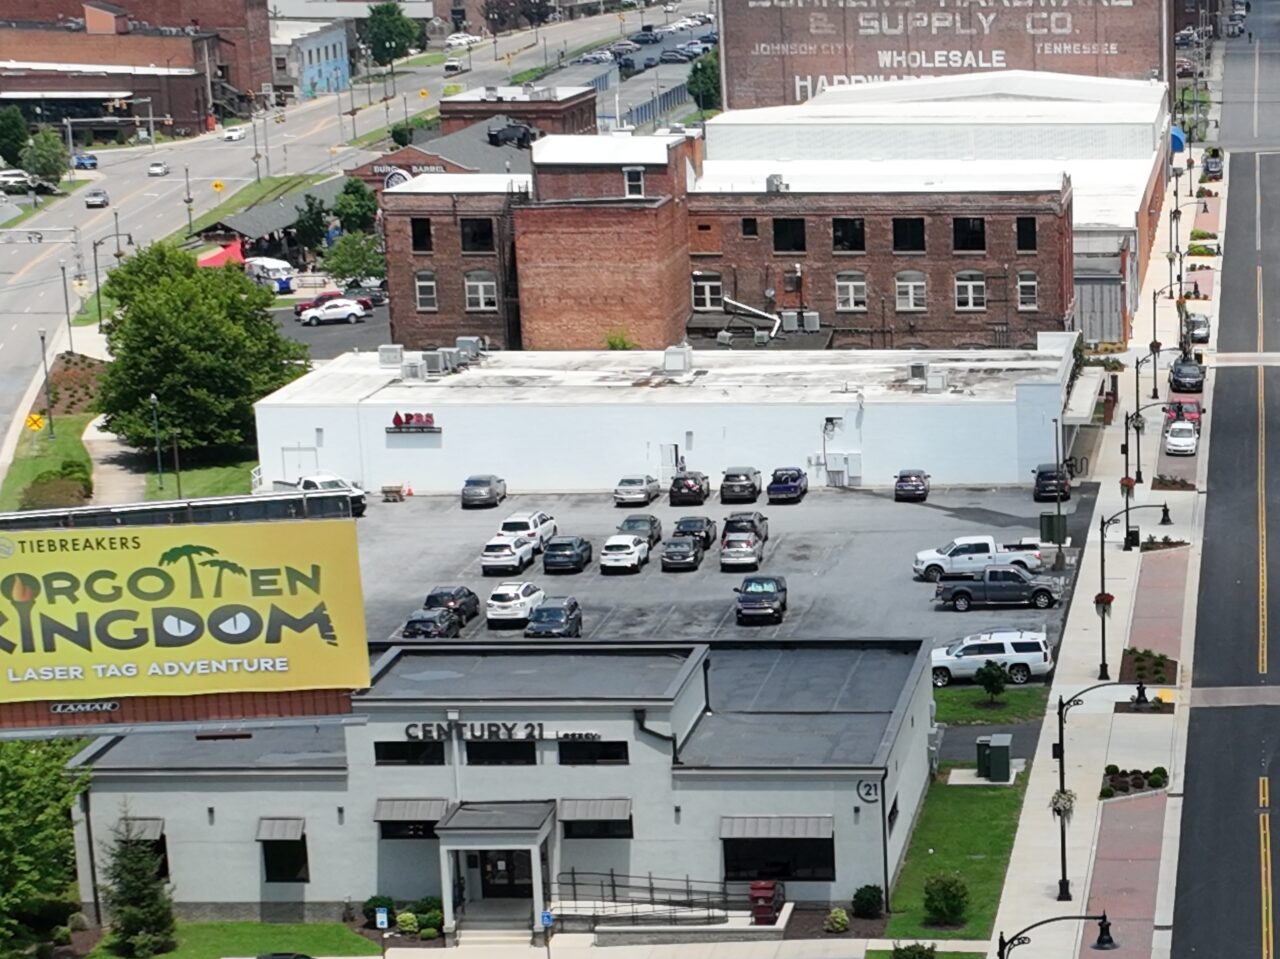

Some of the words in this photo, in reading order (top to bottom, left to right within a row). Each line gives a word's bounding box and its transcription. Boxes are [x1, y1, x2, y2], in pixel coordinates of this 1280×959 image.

[809, 12, 836, 35] &
[858, 12, 997, 35] SUPPLY
[1026, 12, 1080, 35] CO.
[751, 43, 818, 56] JOHNSON
[821, 43, 854, 56] CITY
[1035, 43, 1118, 55] TENNESSEE
[877, 50, 1007, 68] WHOLESALE
[411, 165, 445, 173] BARREL
[18, 536, 142, 554] TIEBREAKERS
[7, 666, 85, 683] LASER
[92, 663, 138, 679] TAG
[147, 656, 290, 677] ADVENTURE
[57, 702, 112, 713] LAMAR
[405, 722, 518, 741] CENTURY
[524, 722, 544, 740] 21
[863, 783, 878, 796] 21
